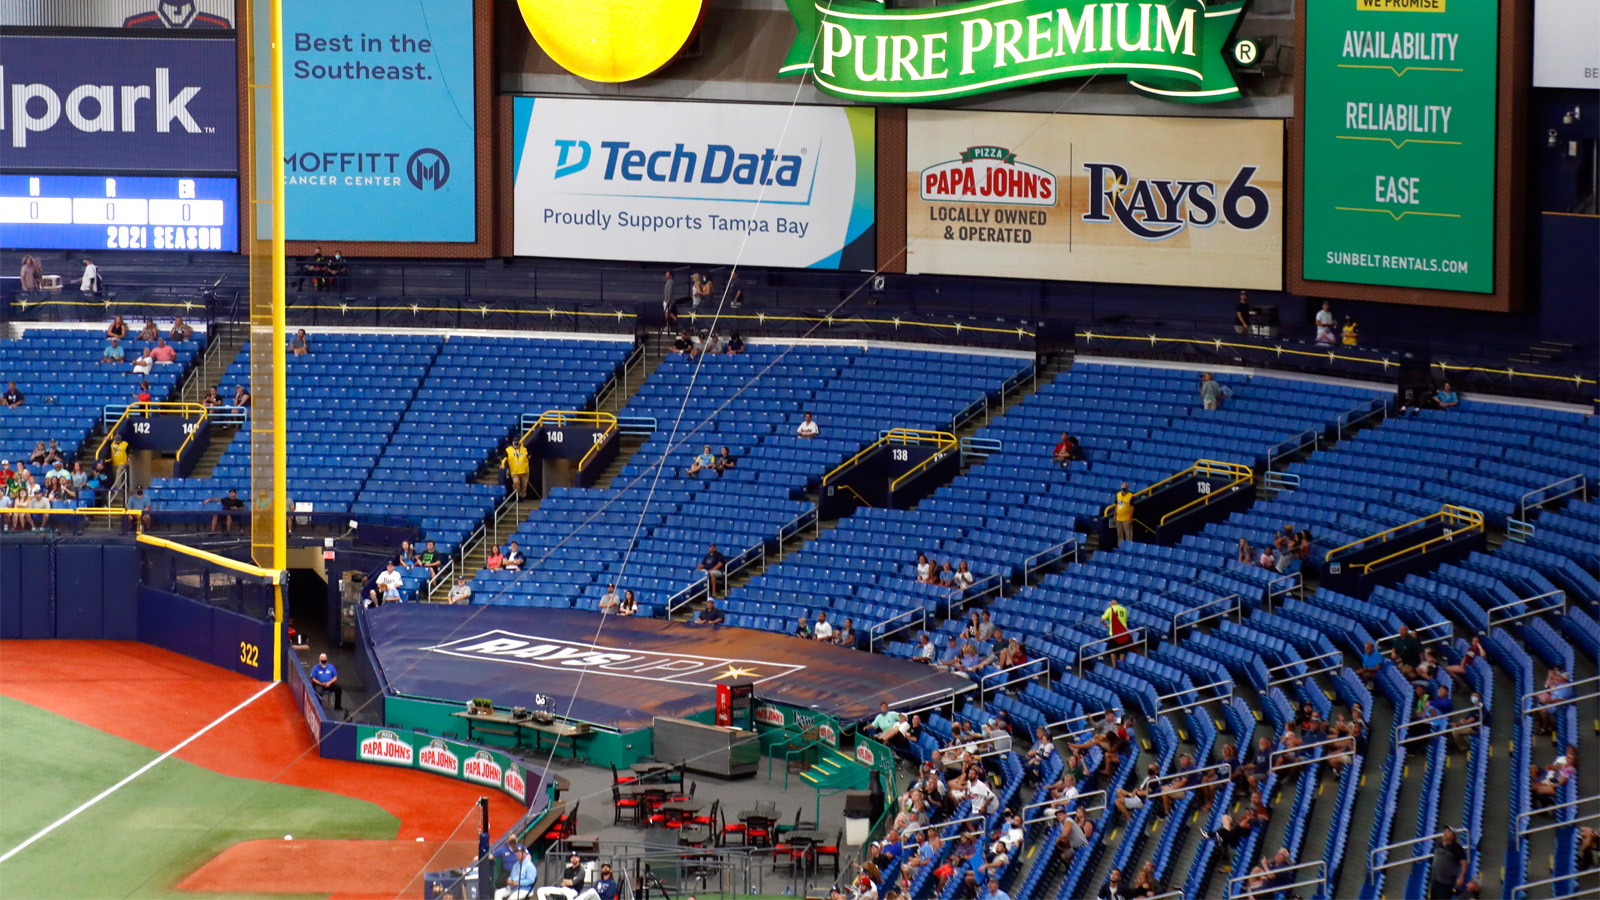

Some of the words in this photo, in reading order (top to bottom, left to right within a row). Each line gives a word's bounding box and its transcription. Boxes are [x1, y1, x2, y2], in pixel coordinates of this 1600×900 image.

[1385, 0, 1439, 9] PROMISE
[294, 32, 353, 53] Best
[360, 32, 382, 52] in
[389, 34, 433, 53] the
[820, 19, 949, 82] PURE
[960, 2, 1197, 76] PREMIUM
[1342, 30, 1459, 61] AVAILABILITY
[293, 59, 433, 80] Southeast.
[1346, 101, 1452, 133] RELIABILITY
[284, 151, 400, 173] MOFFITT
[974, 148, 1003, 159] PIZZA
[344, 176, 401, 187] CENTER
[926, 166, 977, 196] PAPA
[980, 166, 1052, 199] JOHN'S
[1375, 175, 1420, 205] EASE
[1082, 162, 1219, 241] RAYS
[1222, 165, 1270, 231] 6
[543, 208, 611, 230] Proudly
[617, 211, 702, 232] Supports
[708, 214, 770, 235] Tampa
[776, 217, 809, 238] Bay
[930, 206, 990, 223] LOCALLY
[994, 209, 1047, 225] OWNED
[106, 226, 147, 249] 2021
[153, 226, 222, 250] SEASON
[943, 225, 955, 240] &
[958, 226, 1032, 243] OPERATED
[1326, 251, 1468, 275] SUNBELTRENTALS.COM
[133, 422, 151, 434] 142
[546, 431, 564, 443] 140
[892, 449, 908, 462] 138
[1197, 481, 1211, 495] 136
[240, 641, 259, 668] 322
[455, 637, 632, 667] RAYS
[363, 741, 383, 756] PAPA
[383, 742, 411, 760] JOHN'S
[421, 751, 435, 766] PAPA
[436, 751, 457, 772] JOHN'S
[465, 761, 480, 777] PAPA
